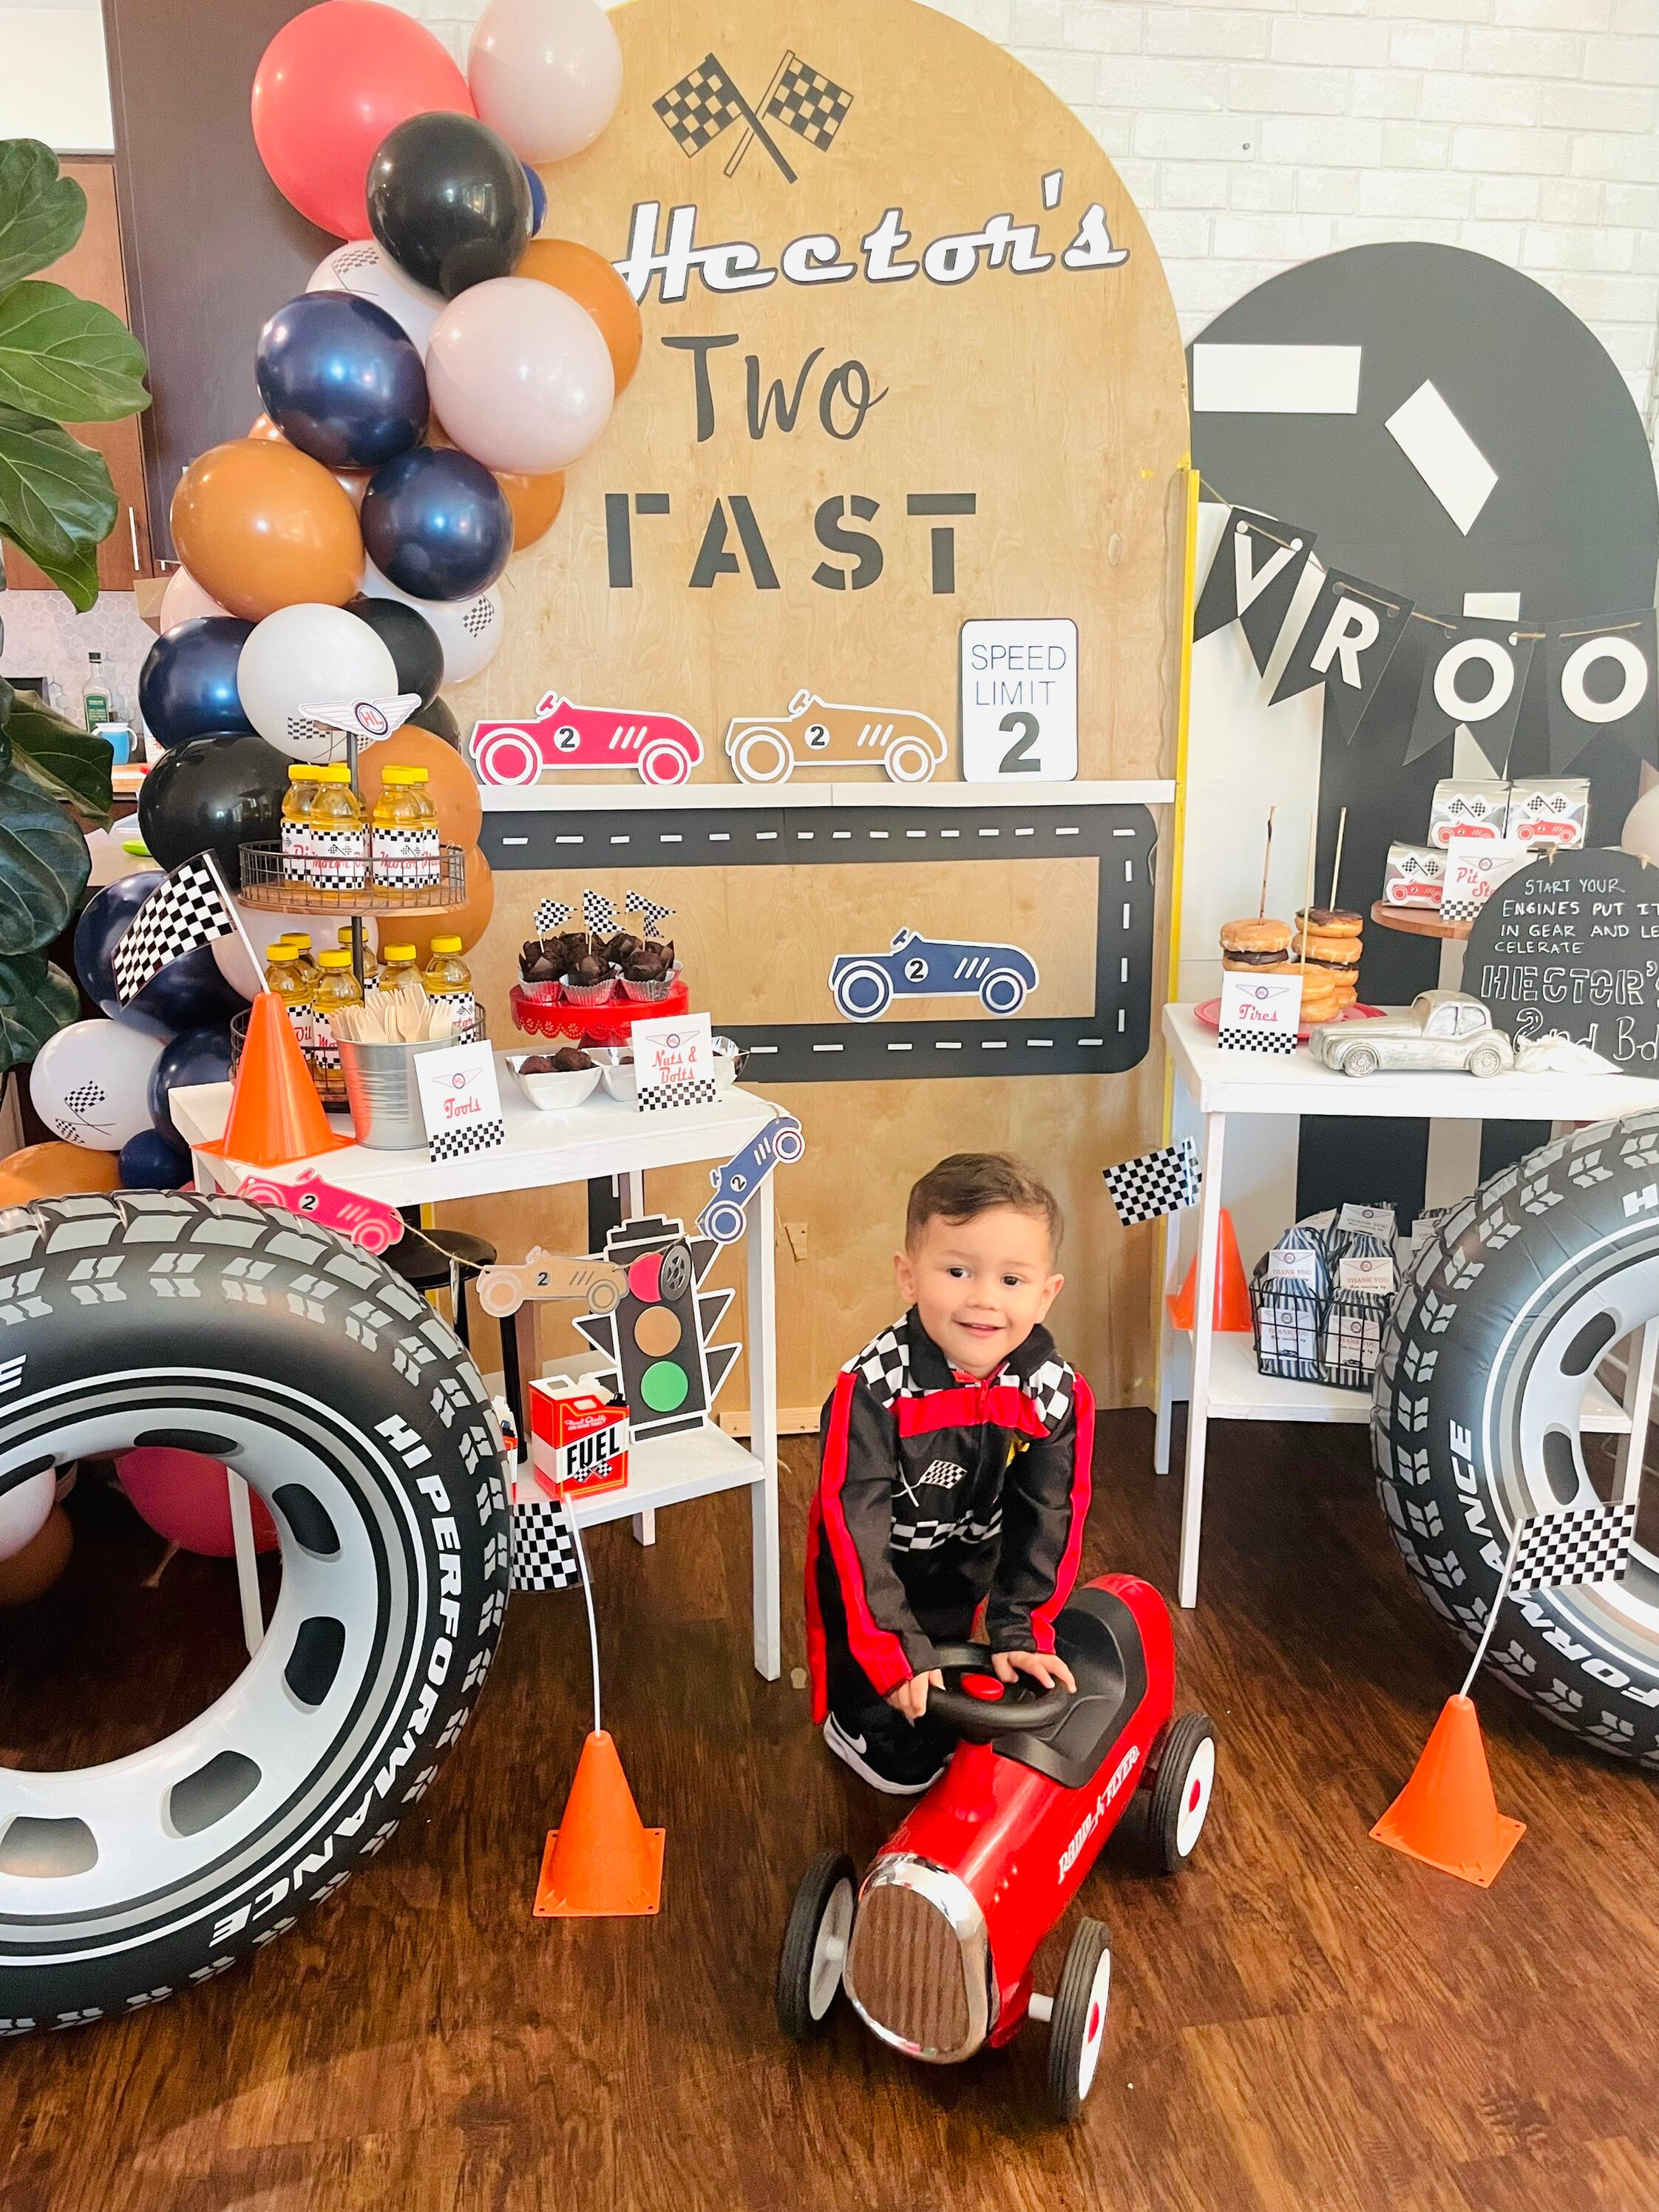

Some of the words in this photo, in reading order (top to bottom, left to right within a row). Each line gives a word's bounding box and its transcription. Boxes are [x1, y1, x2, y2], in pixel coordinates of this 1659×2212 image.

[608, 169, 1130, 305] Hector's
[971, 644, 1066, 671] SPEED
[975, 680, 1056, 706] LIMIT
[560, 727, 576, 749] 2
[810, 726, 826, 747] 2
[998, 711, 1041, 773] 2
[1456, 867, 1478, 883] Pit
[1472, 881, 1496, 898] St
[1524, 879, 1571, 896] START
[1578, 878, 1626, 893] YOUR
[1502, 900, 1581, 917] ENGINES
[1592, 902, 1626, 917] PUT
[1501, 924, 1519, 937] IN
[1528, 923, 1575, 937] GEAR
[1590, 924, 1629, 937] AND
[1494, 940, 1585, 954] CELERATE
[906, 960, 924, 980] 2
[1481, 960, 1659, 1008] HECTOR'
[1238, 1004, 1278, 1022] Tires
[294, 1026, 312, 1042] Oil
[652, 1050, 683, 1067] Nuts
[688, 1046, 697, 1062] &
[659, 1067, 695, 1084] Bolts
[444, 1096, 481, 1119] Tools
[732, 1176, 745, 1190] 2
[302, 1195, 316, 1210] 2
[537, 1272, 548, 1286] 2
[373, 1414, 433, 1470] HI
[566, 1426, 620, 1476] FUEL
[208, 1474, 461, 1948] PERFORMANCE
